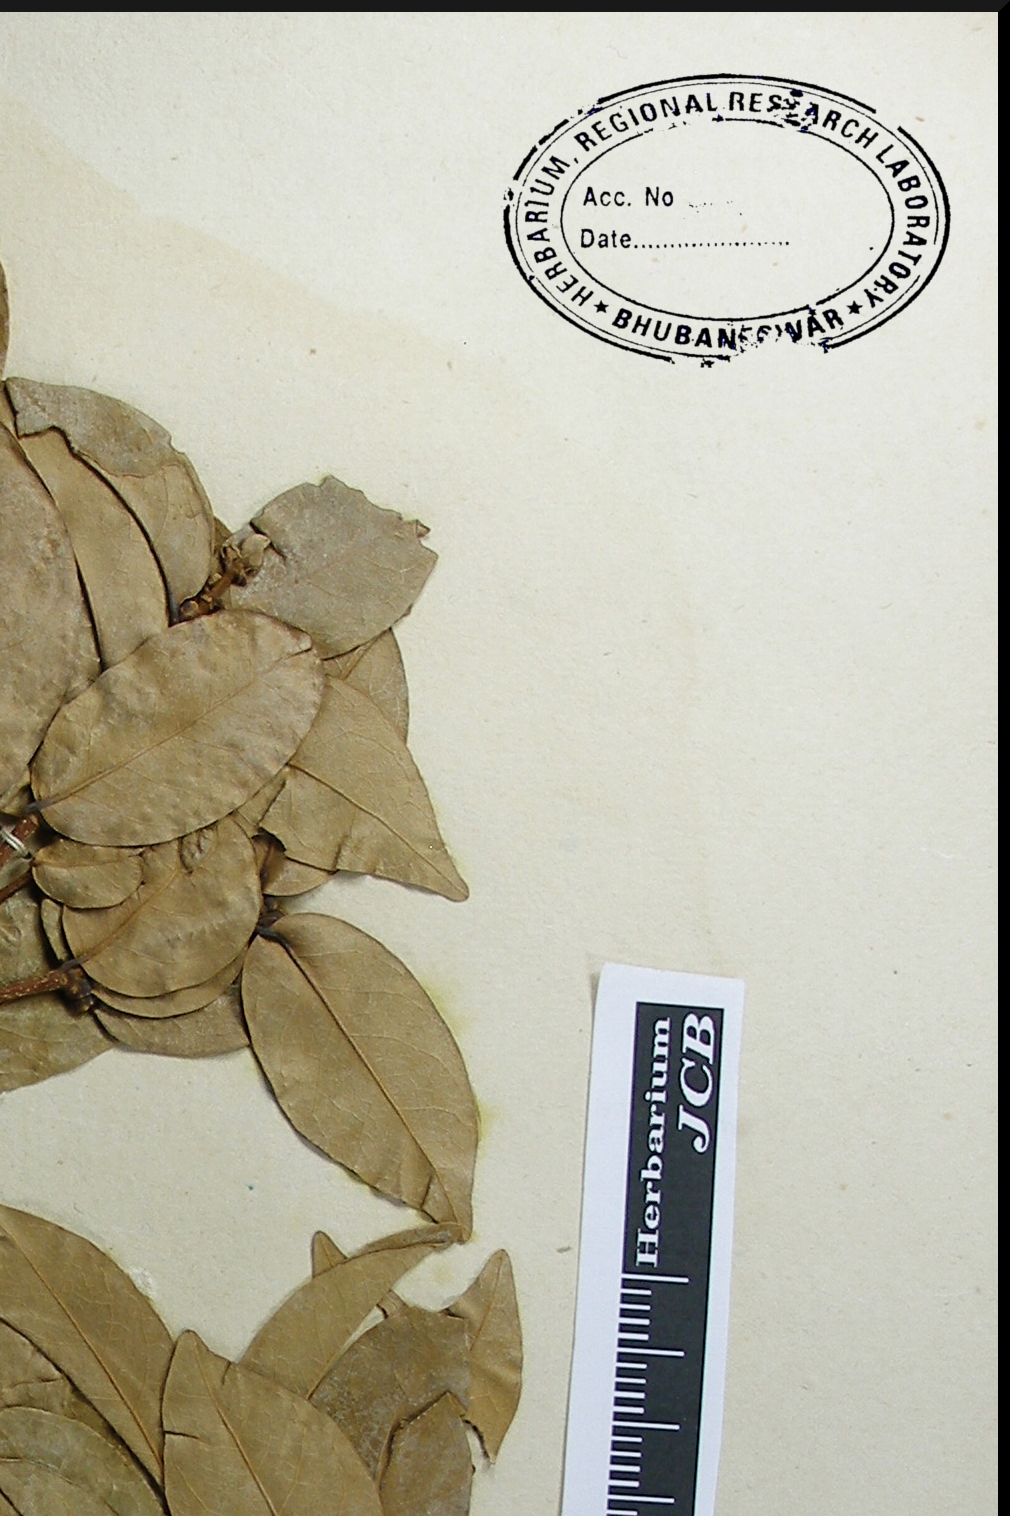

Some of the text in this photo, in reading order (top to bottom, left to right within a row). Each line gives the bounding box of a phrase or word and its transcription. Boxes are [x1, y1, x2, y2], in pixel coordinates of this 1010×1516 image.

[575, 94, 717, 151] REGIONAL
[875, 144, 930, 309] LABORATORY
[583, 187, 674, 207] Acc. No
[635, 1017, 670, 1268] Herbarium
[677, 1012, 715, 1154] JCB
